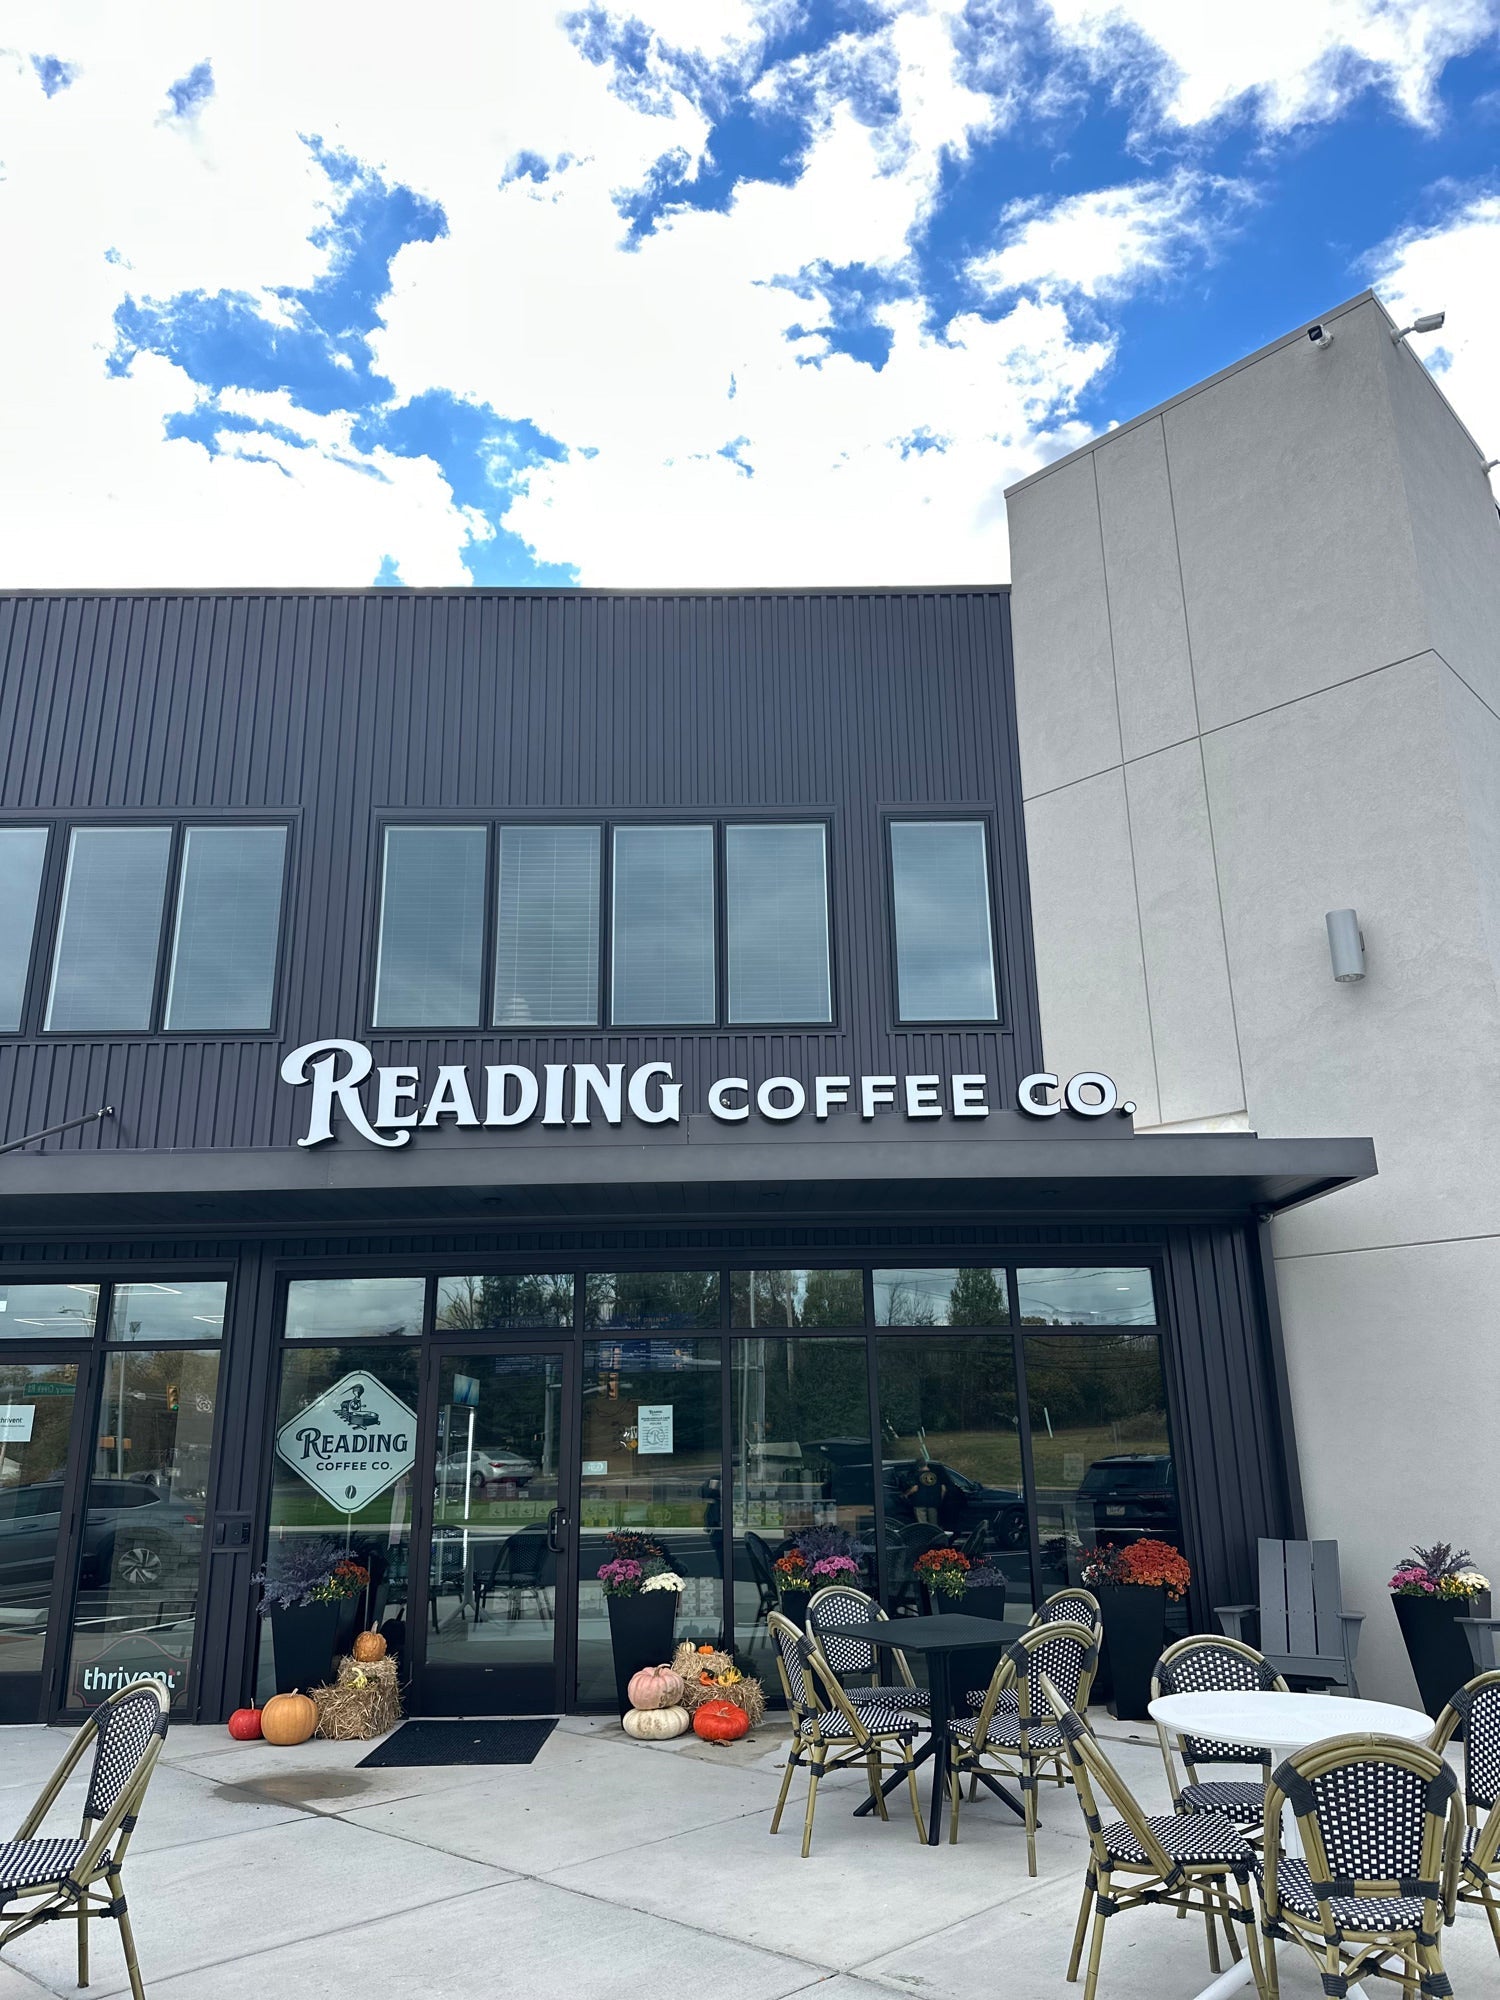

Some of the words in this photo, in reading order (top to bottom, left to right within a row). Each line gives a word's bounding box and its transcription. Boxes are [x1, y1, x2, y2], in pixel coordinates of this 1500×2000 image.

[280, 1039, 682, 1148] READING
[708, 1074, 989, 1120] COFFEE
[1018, 1071, 1137, 1117] CO.
[0, 1416, 23, 1424] hrivent
[295, 1427, 408, 1460] READING
[316, 1462, 367, 1471] COFFEE
[371, 1461, 393, 1470] CO.
